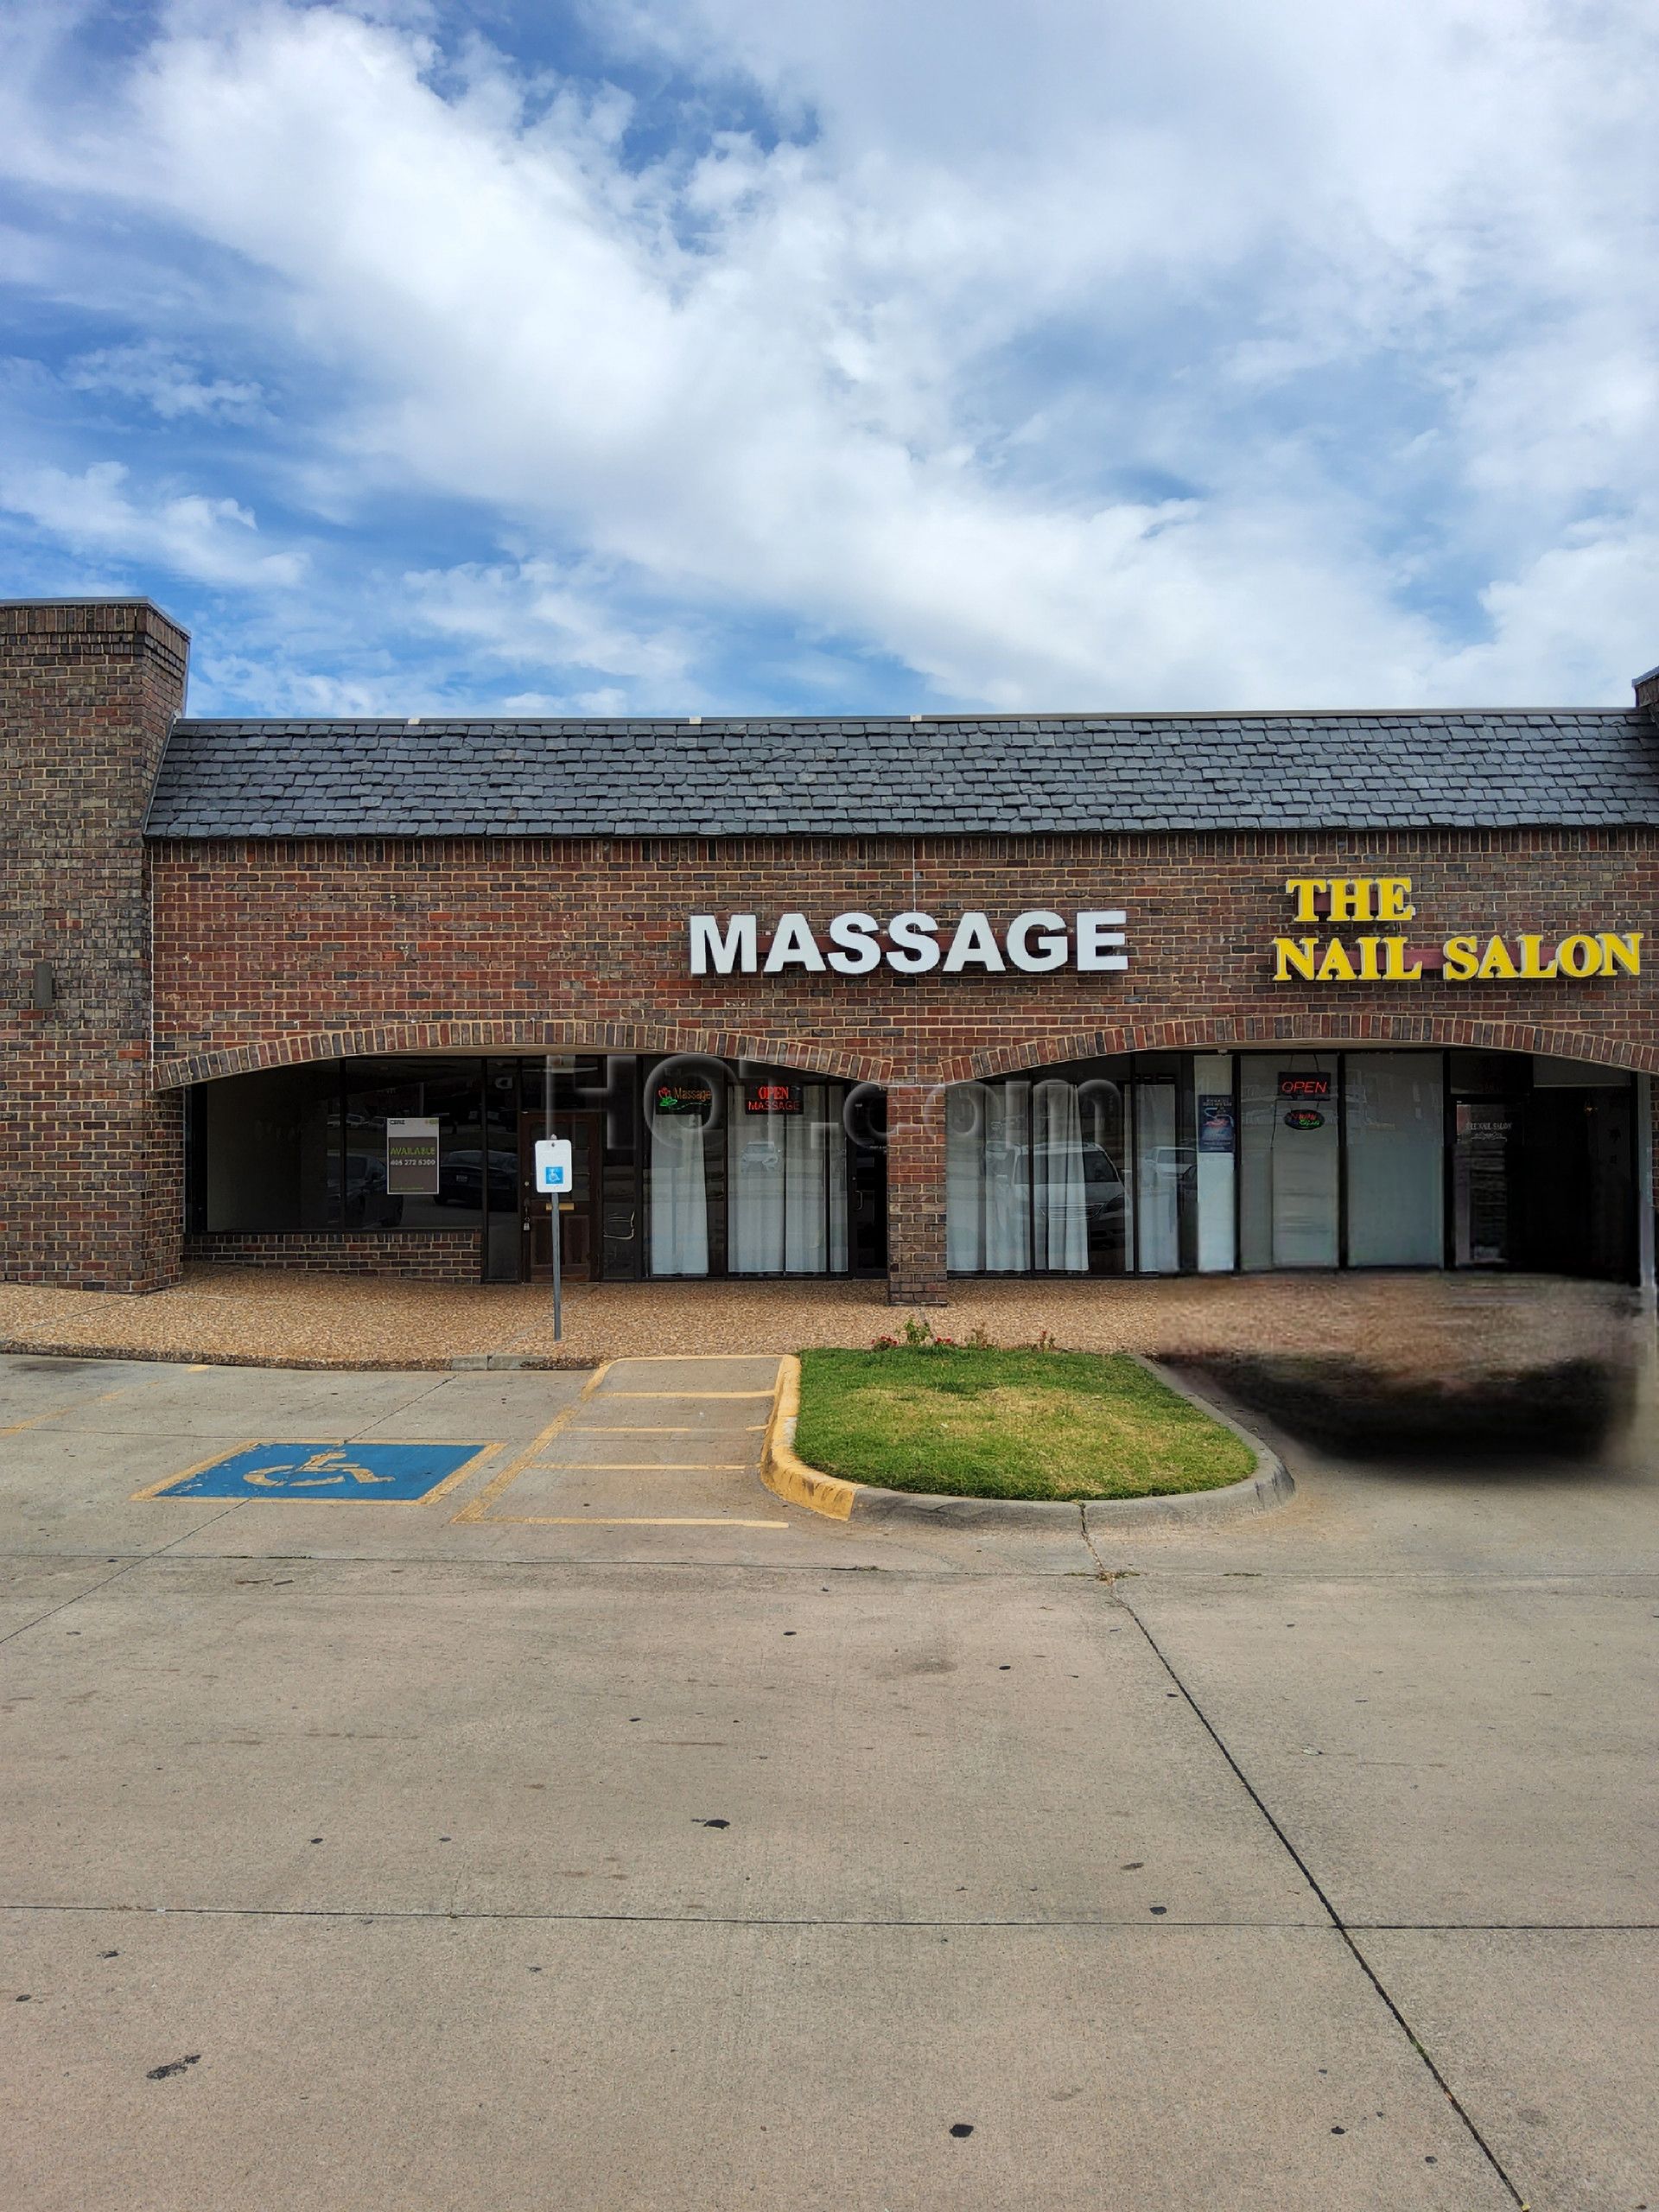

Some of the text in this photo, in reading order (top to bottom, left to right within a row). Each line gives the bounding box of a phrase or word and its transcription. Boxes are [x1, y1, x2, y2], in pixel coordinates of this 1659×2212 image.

[1287, 876, 1416, 923] THE
[690, 910, 1130, 975] MASSAGE
[1273, 931, 1644, 982] NAIL SALON
[674, 1086, 712, 1102] Massage
[758, 1085, 790, 1100] OPEN
[1281, 1081, 1328, 1094] OPEN
[748, 1100, 801, 1111] MASSAGE
[390, 1147, 435, 1156] AVAILABLE
